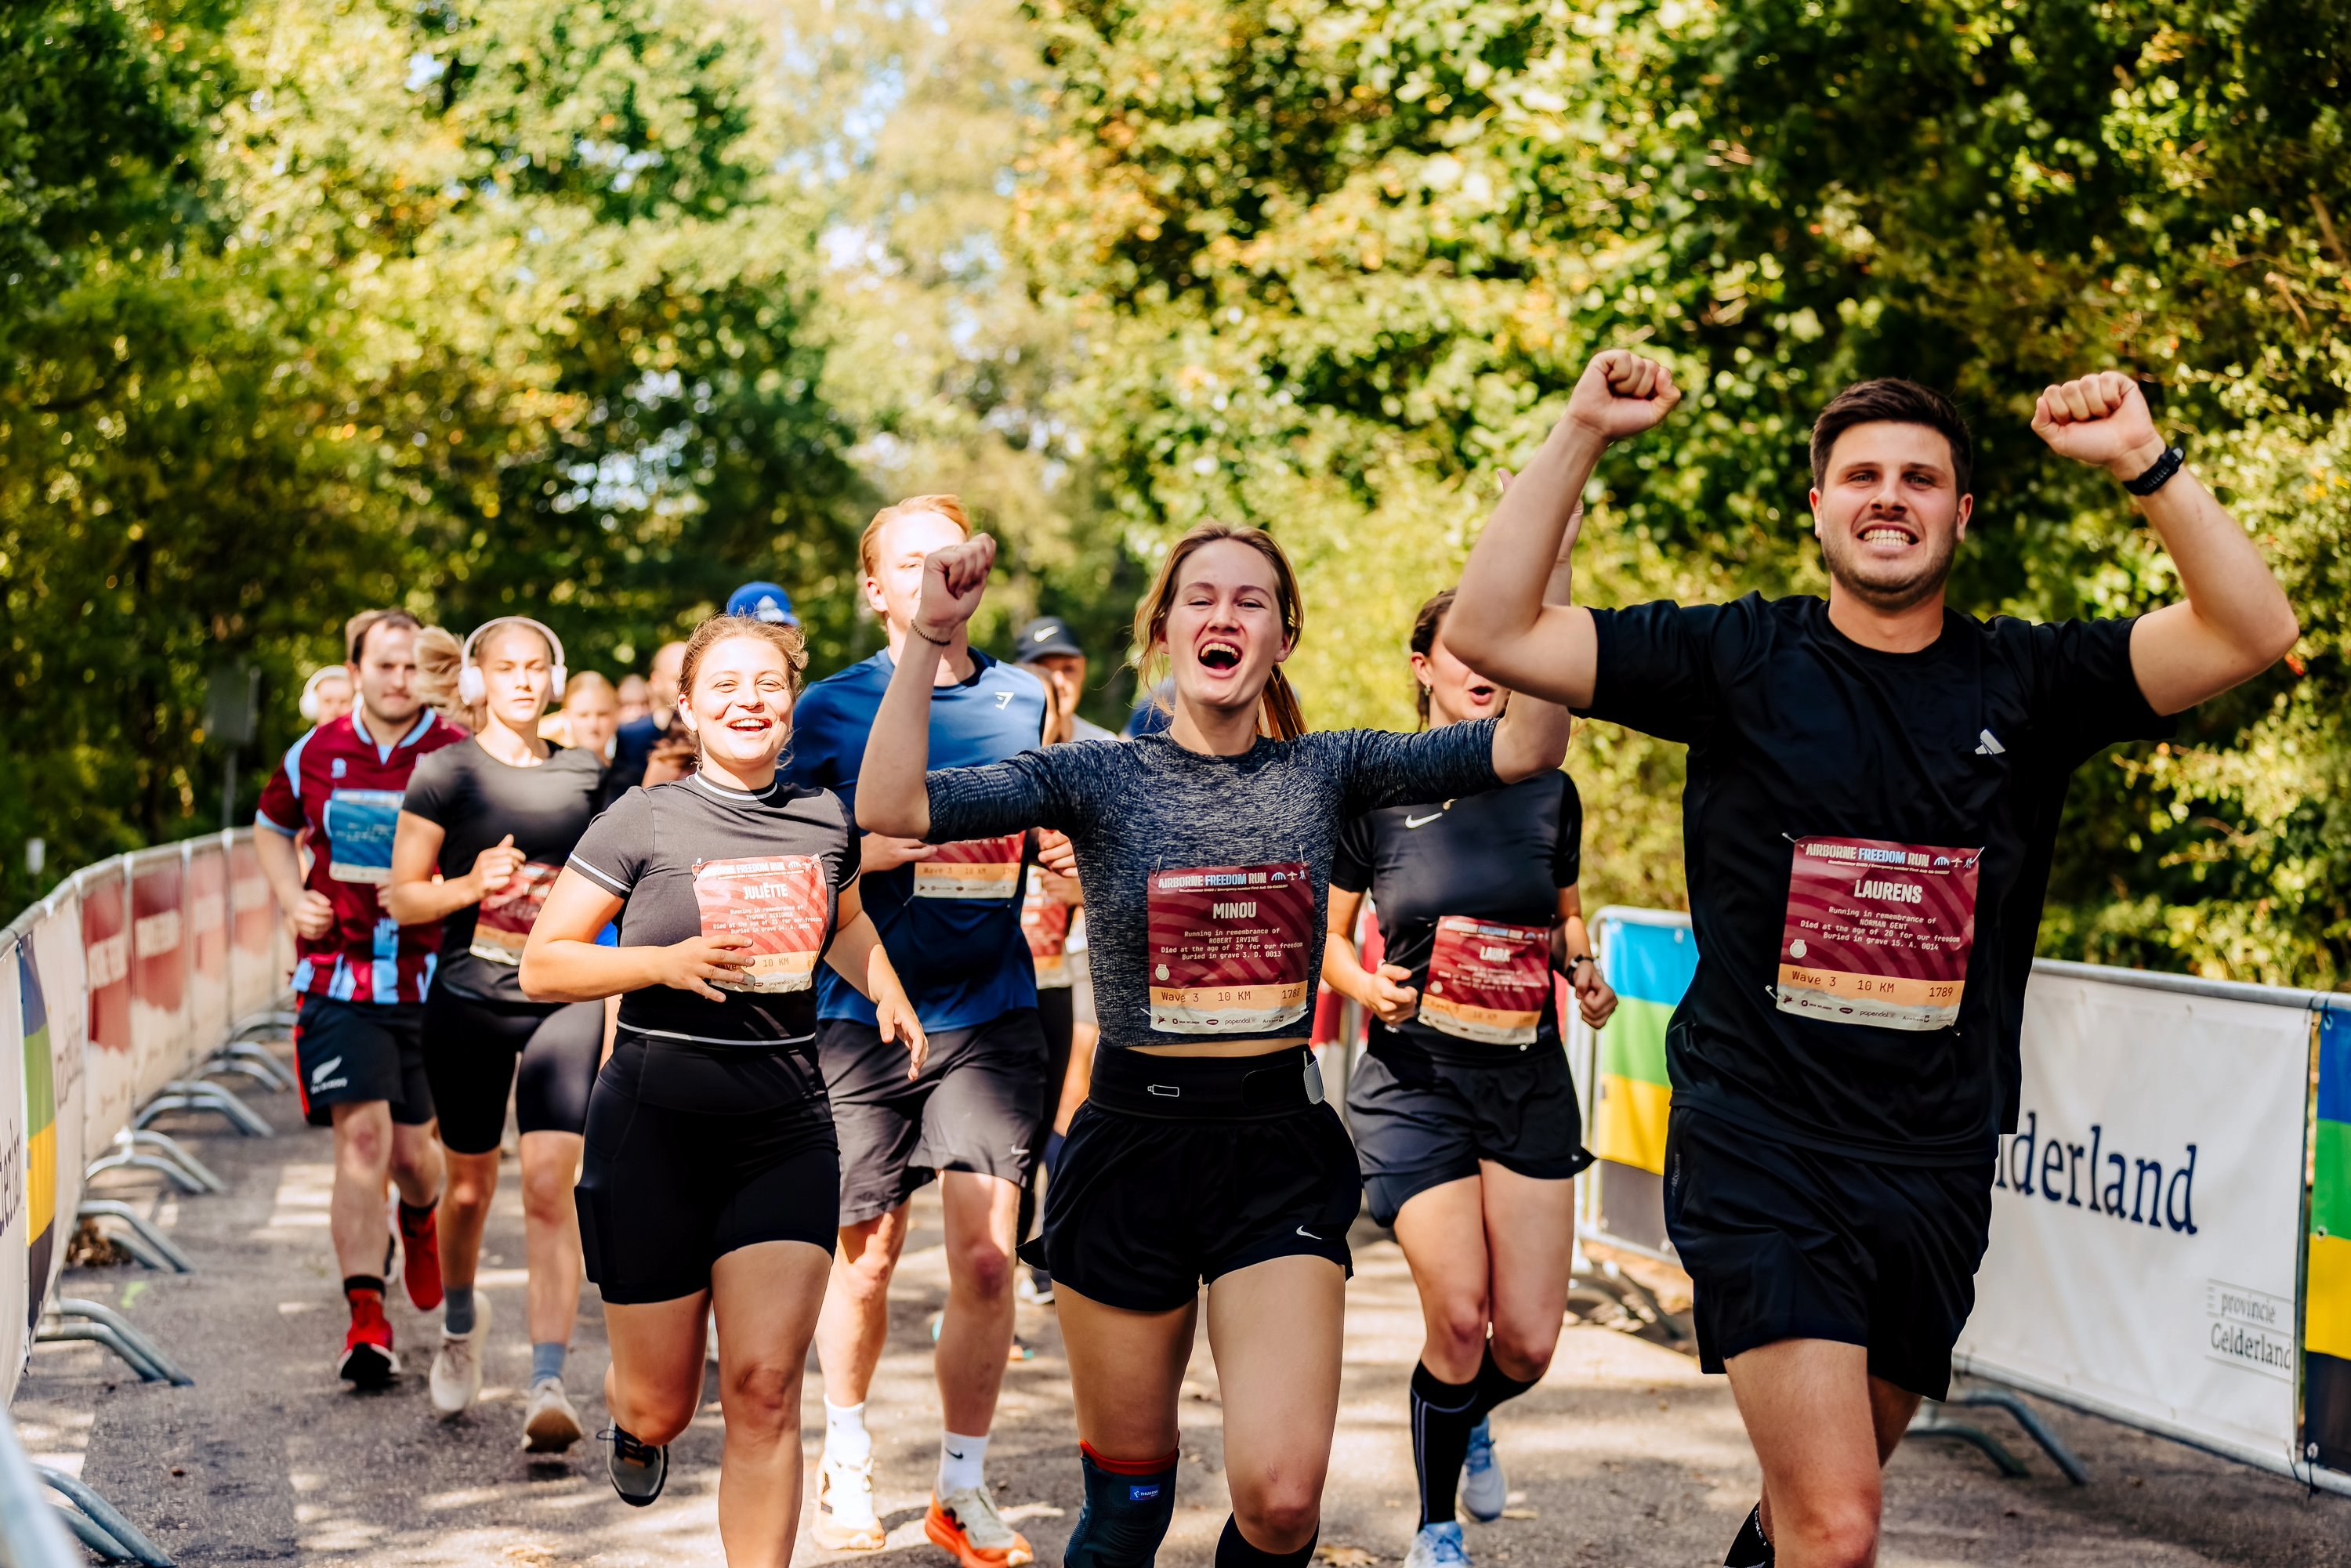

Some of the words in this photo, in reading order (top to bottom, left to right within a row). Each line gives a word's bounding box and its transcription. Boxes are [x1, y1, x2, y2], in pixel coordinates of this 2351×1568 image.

[1806, 843, 1857, 860] AIRBORNE
[1858, 848, 1906, 864] FREEDOM
[1907, 853, 1930, 867] RUN
[737, 864, 770, 874] FREEDOM
[1158, 875, 1204, 889] AIRBORNE
[1204, 873, 1247, 886] FREEDOM
[1248, 872, 1267, 885] RUN
[1853, 879, 1923, 904] LAURENS
[1212, 902, 1257, 919] MINOU
[1828, 906, 1860, 917] Running
[1876, 912, 1924, 924] remembrance
[1800, 919, 1819, 929] Died
[1835, 924, 1849, 932] the
[1852, 927, 1866, 936] age
[1869, 927, 1878, 936] of
[1900, 931, 1913, 940] for
[1933, 934, 1961, 943] freedom
[1860, 918, 1886, 929] NORMAN
[1823, 931, 1850, 942] Buried
[1853, 934, 1864, 943] in
[1866, 936, 1889, 946] grave
[1891, 939, 1904, 947] 15.
[763, 958, 773, 967] 10
[1791, 970, 1822, 986] Wave
[1829, 976, 1837, 987] 3
[1857, 980, 1872, 990] 10
[1879, 982, 1895, 994] KM
[1929, 986, 1954, 998] 1789
[1161, 991, 1186, 1003] Wave
[1193, 993, 1199, 1002] 3
[1218, 991, 1231, 1001] 10
[1237, 991, 1252, 1001] KM
[2221, 1292, 2277, 1324] provincie
